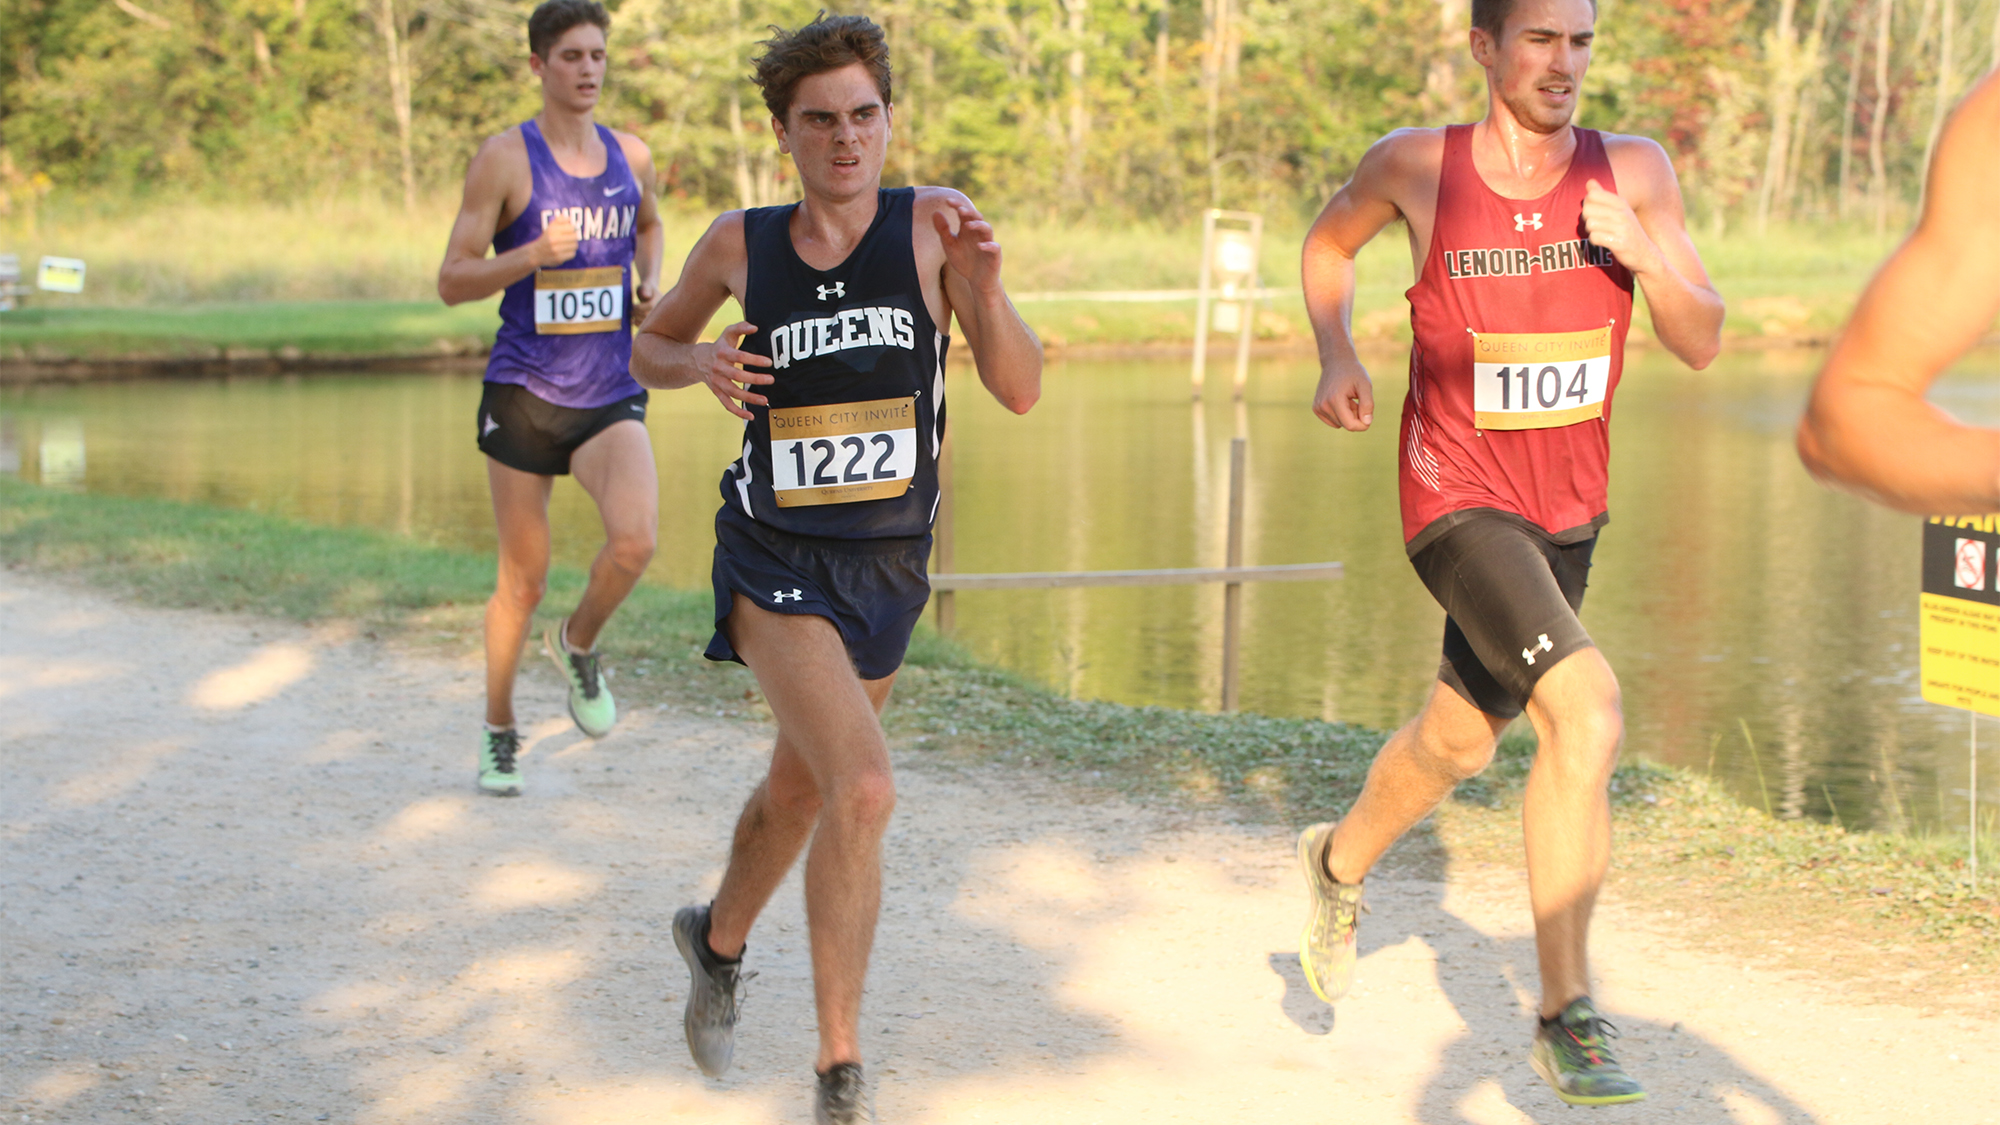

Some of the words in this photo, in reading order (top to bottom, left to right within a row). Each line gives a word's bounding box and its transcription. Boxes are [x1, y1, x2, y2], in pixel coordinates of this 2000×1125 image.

[547, 289, 613, 321] 1050
[770, 306, 915, 370] QUEENS
[1480, 341, 1528, 353] QUEEN
[1535, 341, 1564, 353] CITY
[1569, 337, 1606, 350] INVITE
[1496, 362, 1589, 410] 1104
[775, 414, 823, 429] QUEEN
[829, 411, 859, 425] CITY
[865, 407, 909, 421] INVITE
[789, 433, 898, 487] 1222
